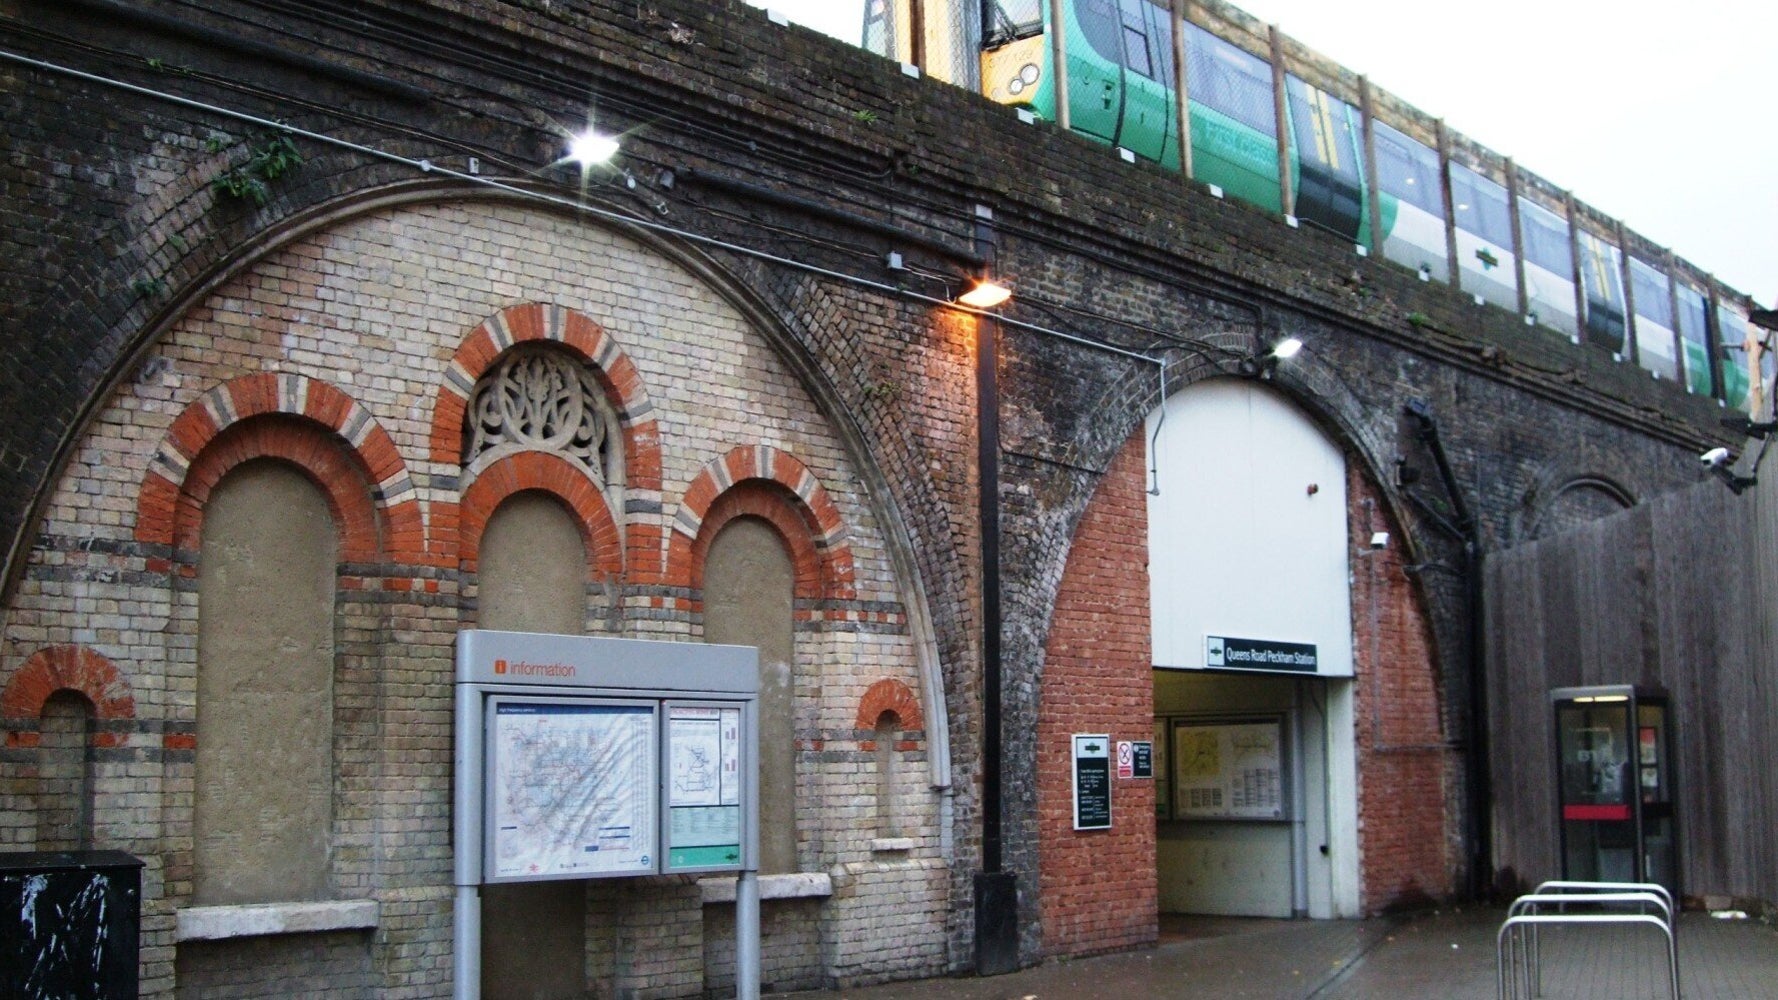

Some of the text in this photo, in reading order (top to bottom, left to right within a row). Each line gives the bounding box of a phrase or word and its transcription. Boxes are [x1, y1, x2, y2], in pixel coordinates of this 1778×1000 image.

[1226, 646, 1316, 665] Queens Road Peckham Station
[510, 661, 576, 676] information
